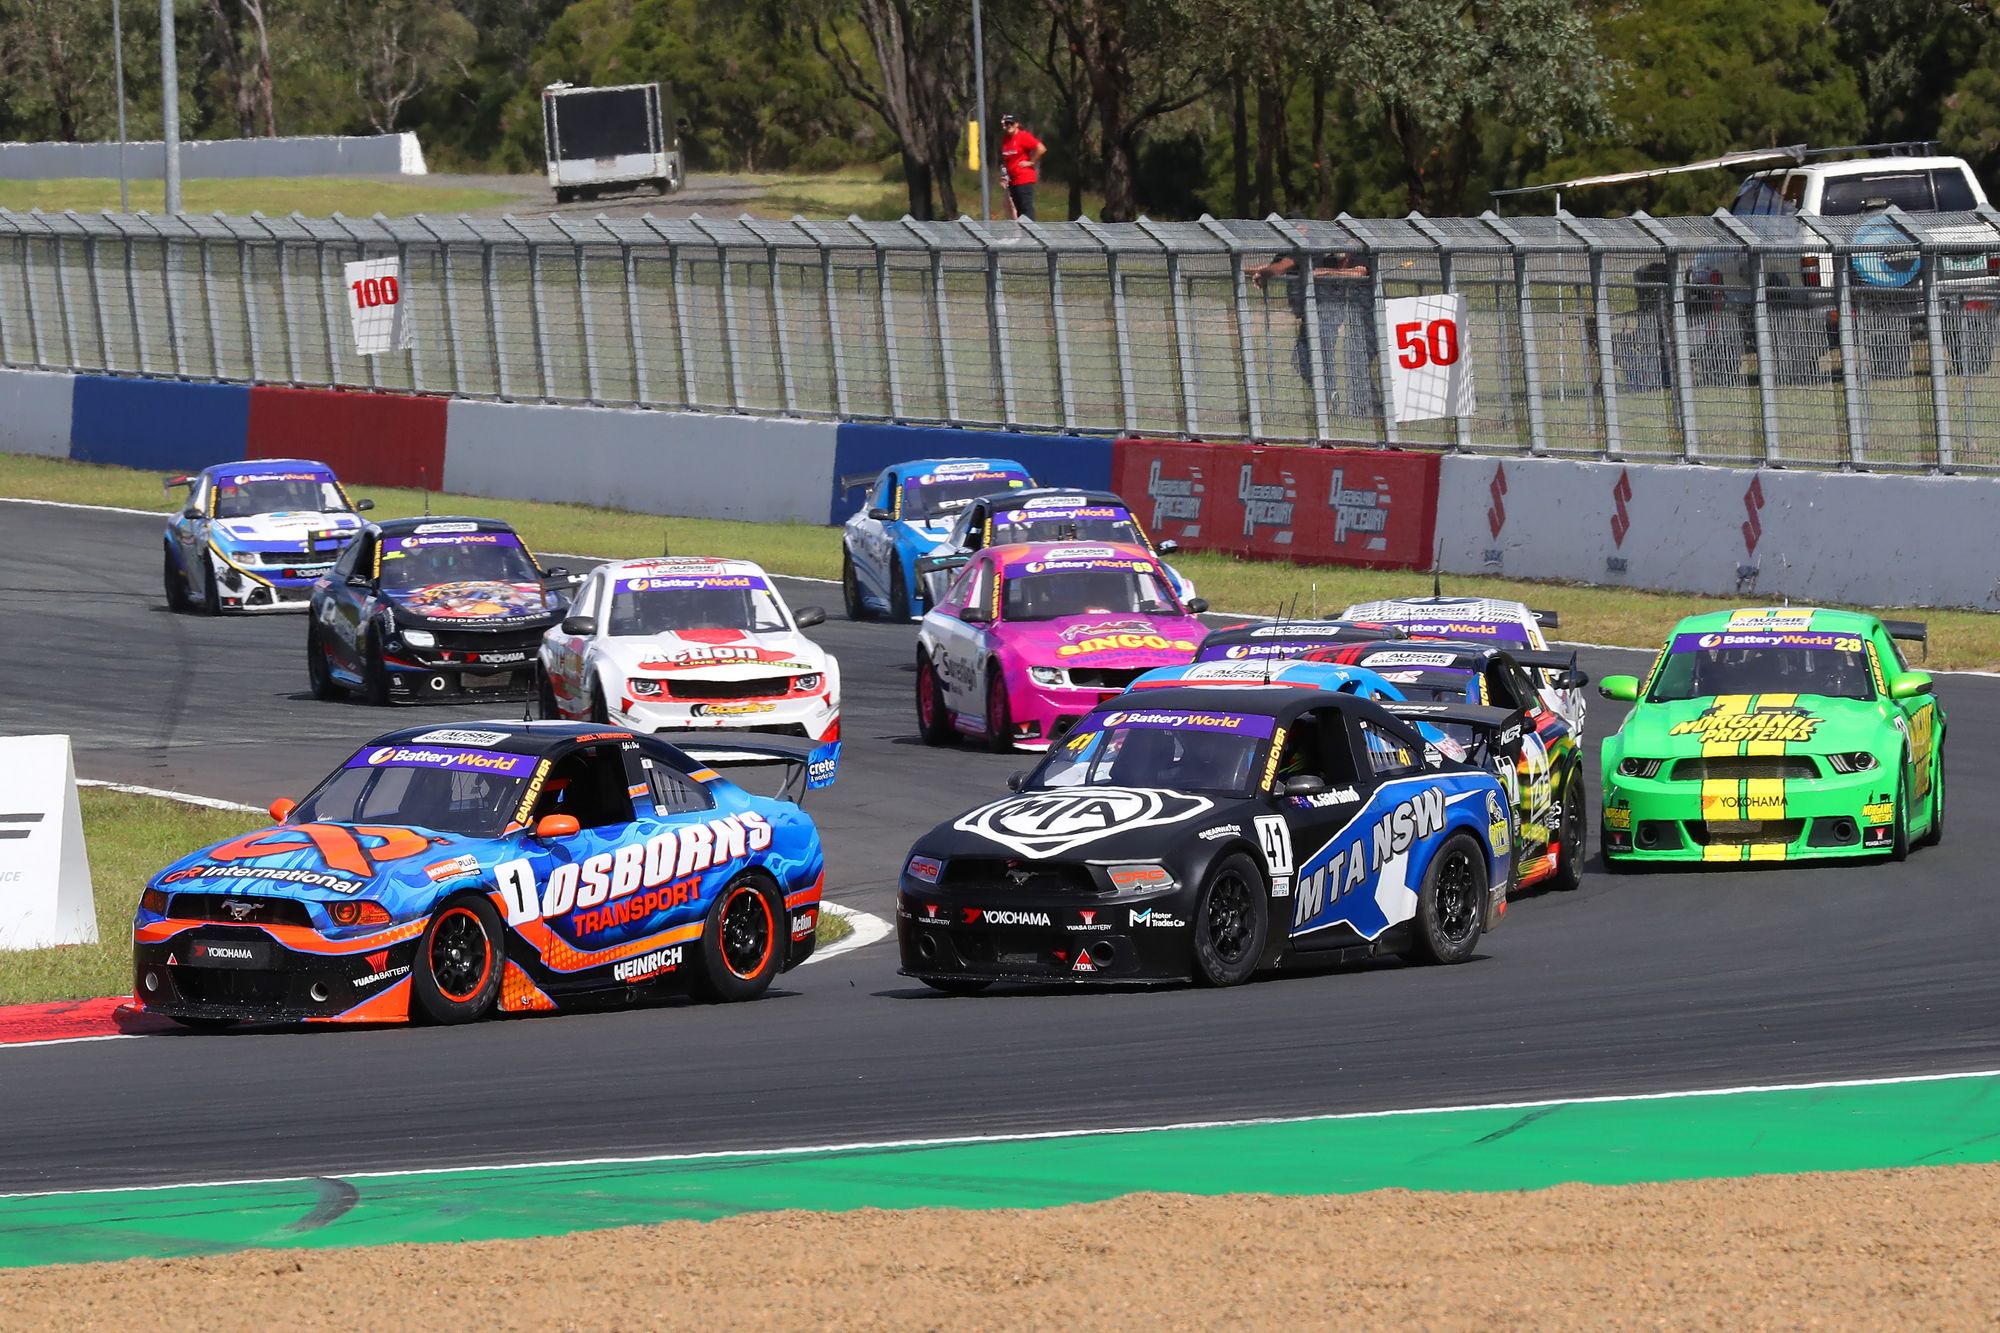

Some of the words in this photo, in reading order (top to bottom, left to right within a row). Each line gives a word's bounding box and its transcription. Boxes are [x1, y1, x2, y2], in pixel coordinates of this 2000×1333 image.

[352, 276, 399, 308] 100
[1396, 319, 1459, 369] 50
[1028, 509, 1115, 519] BatteryWorld
[419, 536, 497, 545] BatteryWorld
[296, 567, 332, 578] YOKOHAM
[1045, 559, 1132, 569] BatteryWorld
[1132, 561, 1154, 573] 69
[650, 577, 751, 588] BatteryWorld
[1723, 634, 1834, 646] BatteryWorld
[1834, 638, 1862, 652] 28
[479, 652, 525, 664] YOKOHAMA
[704, 702, 777, 715] Roadline
[1126, 712, 1243, 729] BatteryWorld
[1066, 732, 1096, 750] 41
[1699, 726, 1813, 743] PROTEINS
[392, 749, 519, 771] BatteryWorld
[809, 759, 835, 775] crete
[1261, 757, 1276, 792] GAME
[1270, 727, 1287, 760] OVER
[515, 789, 537, 824] GAME
[530, 758, 552, 793] OVER
[1720, 796, 1789, 808] YOKOHAMA
[997, 797, 1118, 830] MTA
[1199, 824, 1242, 840] SHEARWATER
[1371, 786, 1446, 872] NSW
[1265, 822, 1286, 867] 41
[426, 862, 457, 880] MOWERS
[458, 857, 477, 867] PLUS
[542, 811, 773, 919] OSBORN'S
[201, 866, 364, 894] International
[1295, 840, 1366, 927] MTA
[509, 869, 526, 914] 1
[573, 876, 703, 937] TRANSPORT
[983, 910, 1051, 926] YOKOHAMA
[1152, 919, 1174, 927] Trades
[206, 947, 253, 960] YOKOHAMA
[614, 946, 683, 981] HEINRICH
[353, 972, 381, 988] YUASA
[380, 964, 410, 980] BATTERY
